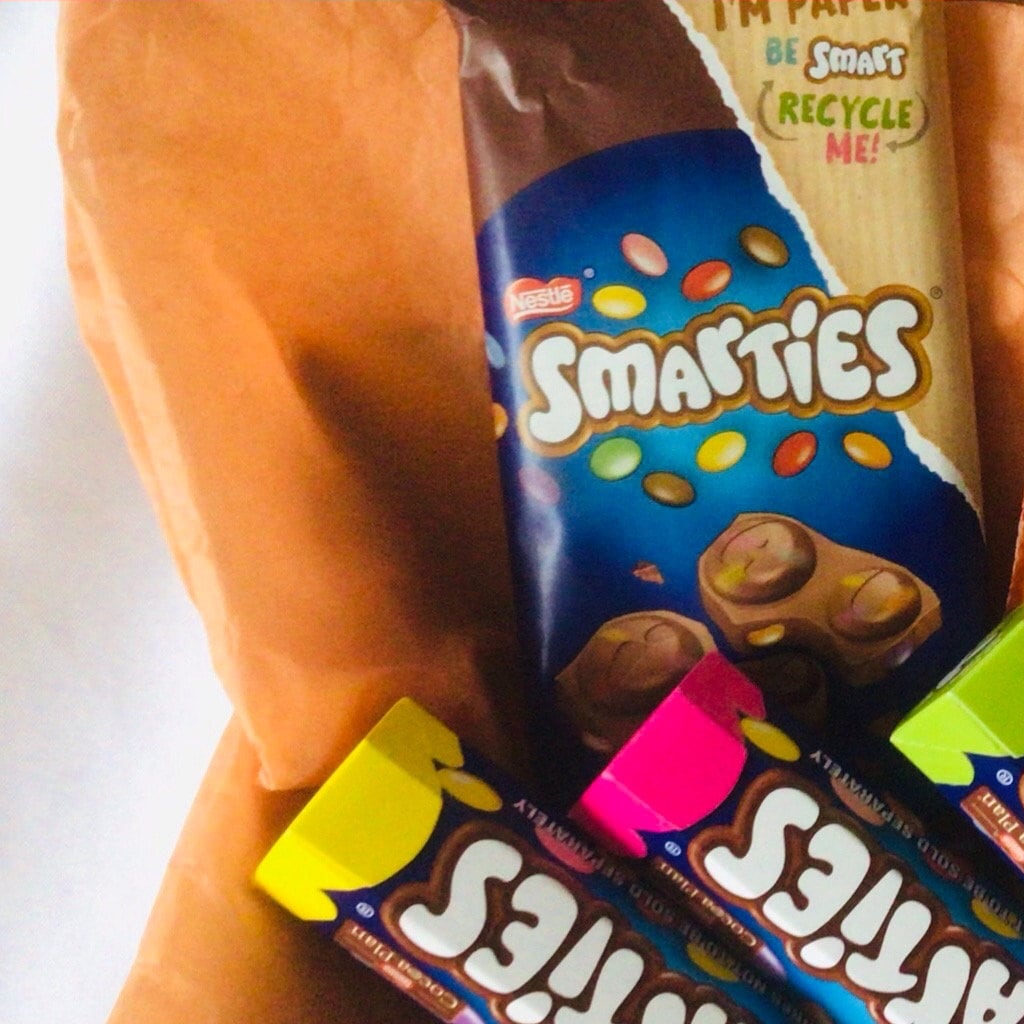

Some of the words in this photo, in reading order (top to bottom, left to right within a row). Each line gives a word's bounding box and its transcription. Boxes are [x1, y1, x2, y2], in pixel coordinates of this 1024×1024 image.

[788, 0, 909, 24] PAP
[766, 36, 799, 66] BE
[809, 41, 906, 80] SMART
[778, 91, 914, 129] RECYCLE
[826, 132, 881, 165] ME!
[528, 298, 919, 443] SMARTIES
[810, 749, 914, 839] SEPARATELY
[982, 793, 1020, 833] Plan
[917, 837, 961, 879] SOLD
[350, 925, 395, 962] Plan
[399, 839, 728, 1024] TIES
[397, 959, 458, 1009] Cocoa
